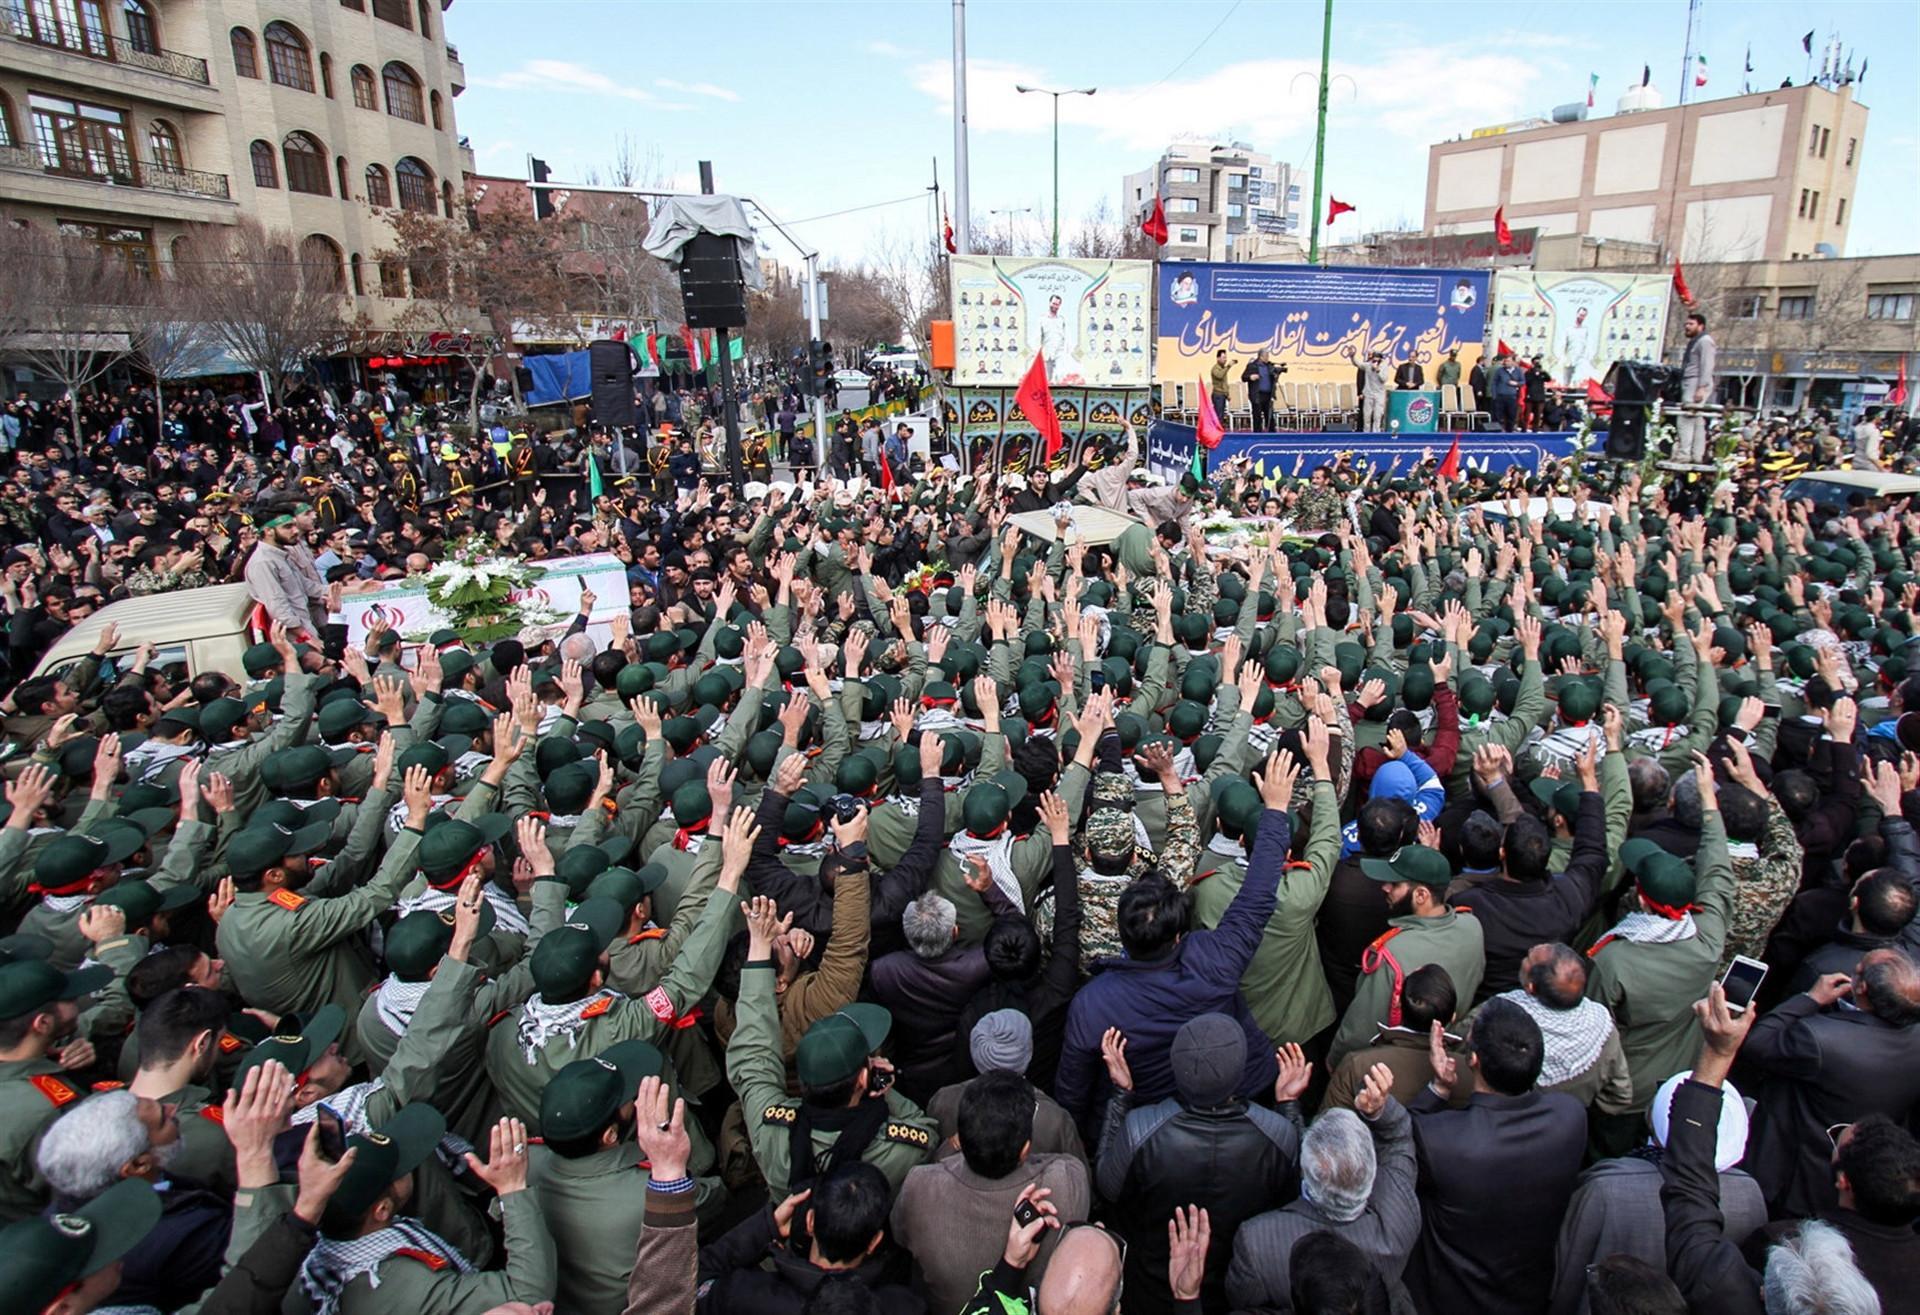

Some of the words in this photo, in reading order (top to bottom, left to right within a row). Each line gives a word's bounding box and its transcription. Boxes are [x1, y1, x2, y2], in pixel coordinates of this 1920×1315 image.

[1180, 309, 1238, 357] اسلامی
[1235, 310, 1308, 356] انقلاب
[1305, 312, 1371, 358] امنیت
[1364, 321, 1407, 364] حریم
[1391, 305, 1463, 370] مدافعین
